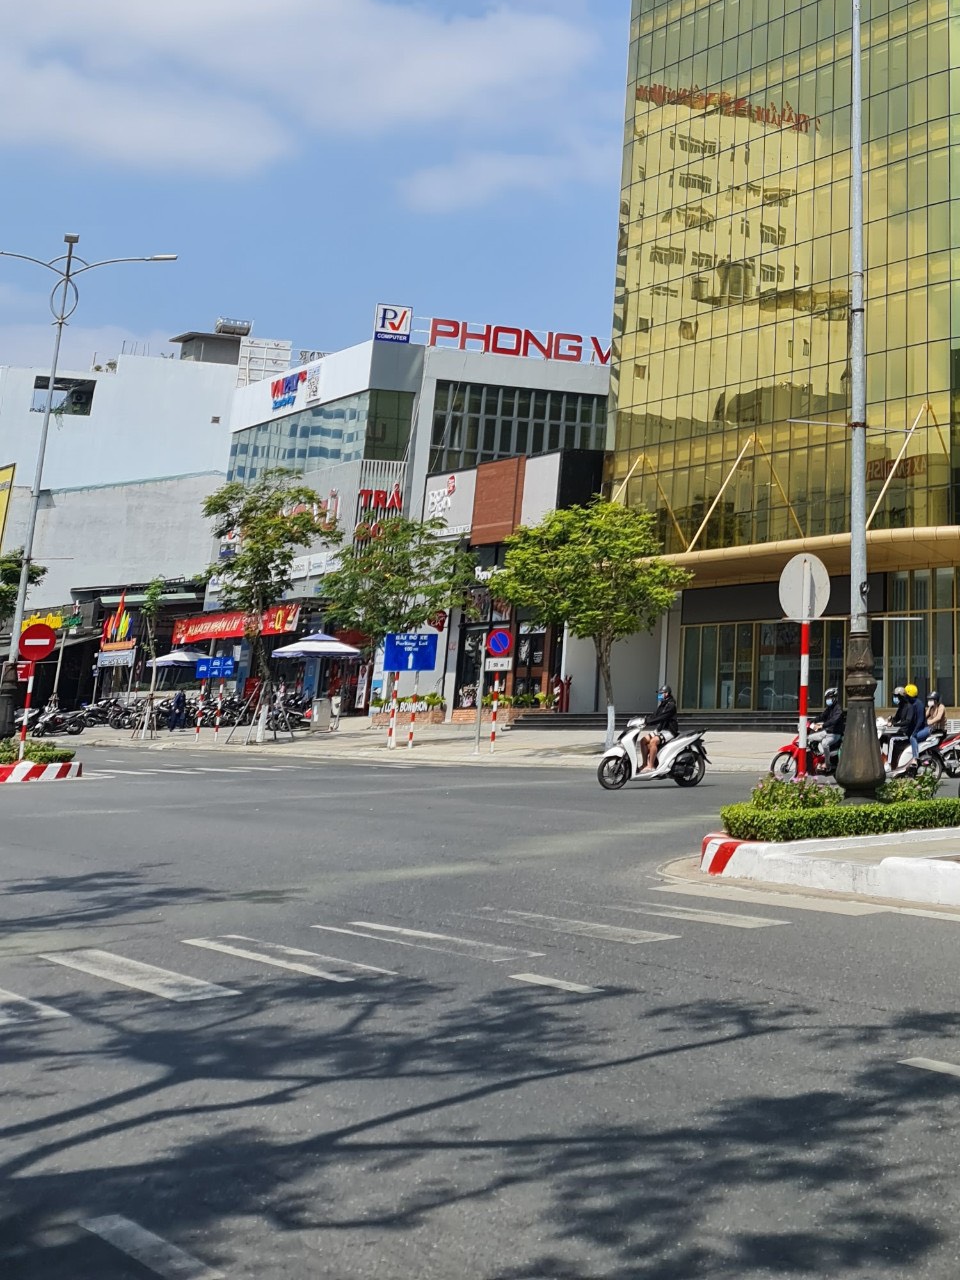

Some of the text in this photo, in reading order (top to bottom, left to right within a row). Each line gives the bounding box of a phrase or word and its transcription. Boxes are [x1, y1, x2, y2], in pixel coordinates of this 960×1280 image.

[376, 333, 408, 342] COMPUTER
[429, 317, 583, 363] PHONG
[358, 483, 403, 513] TRẢ
[400, 701, 428, 713] BONHON
